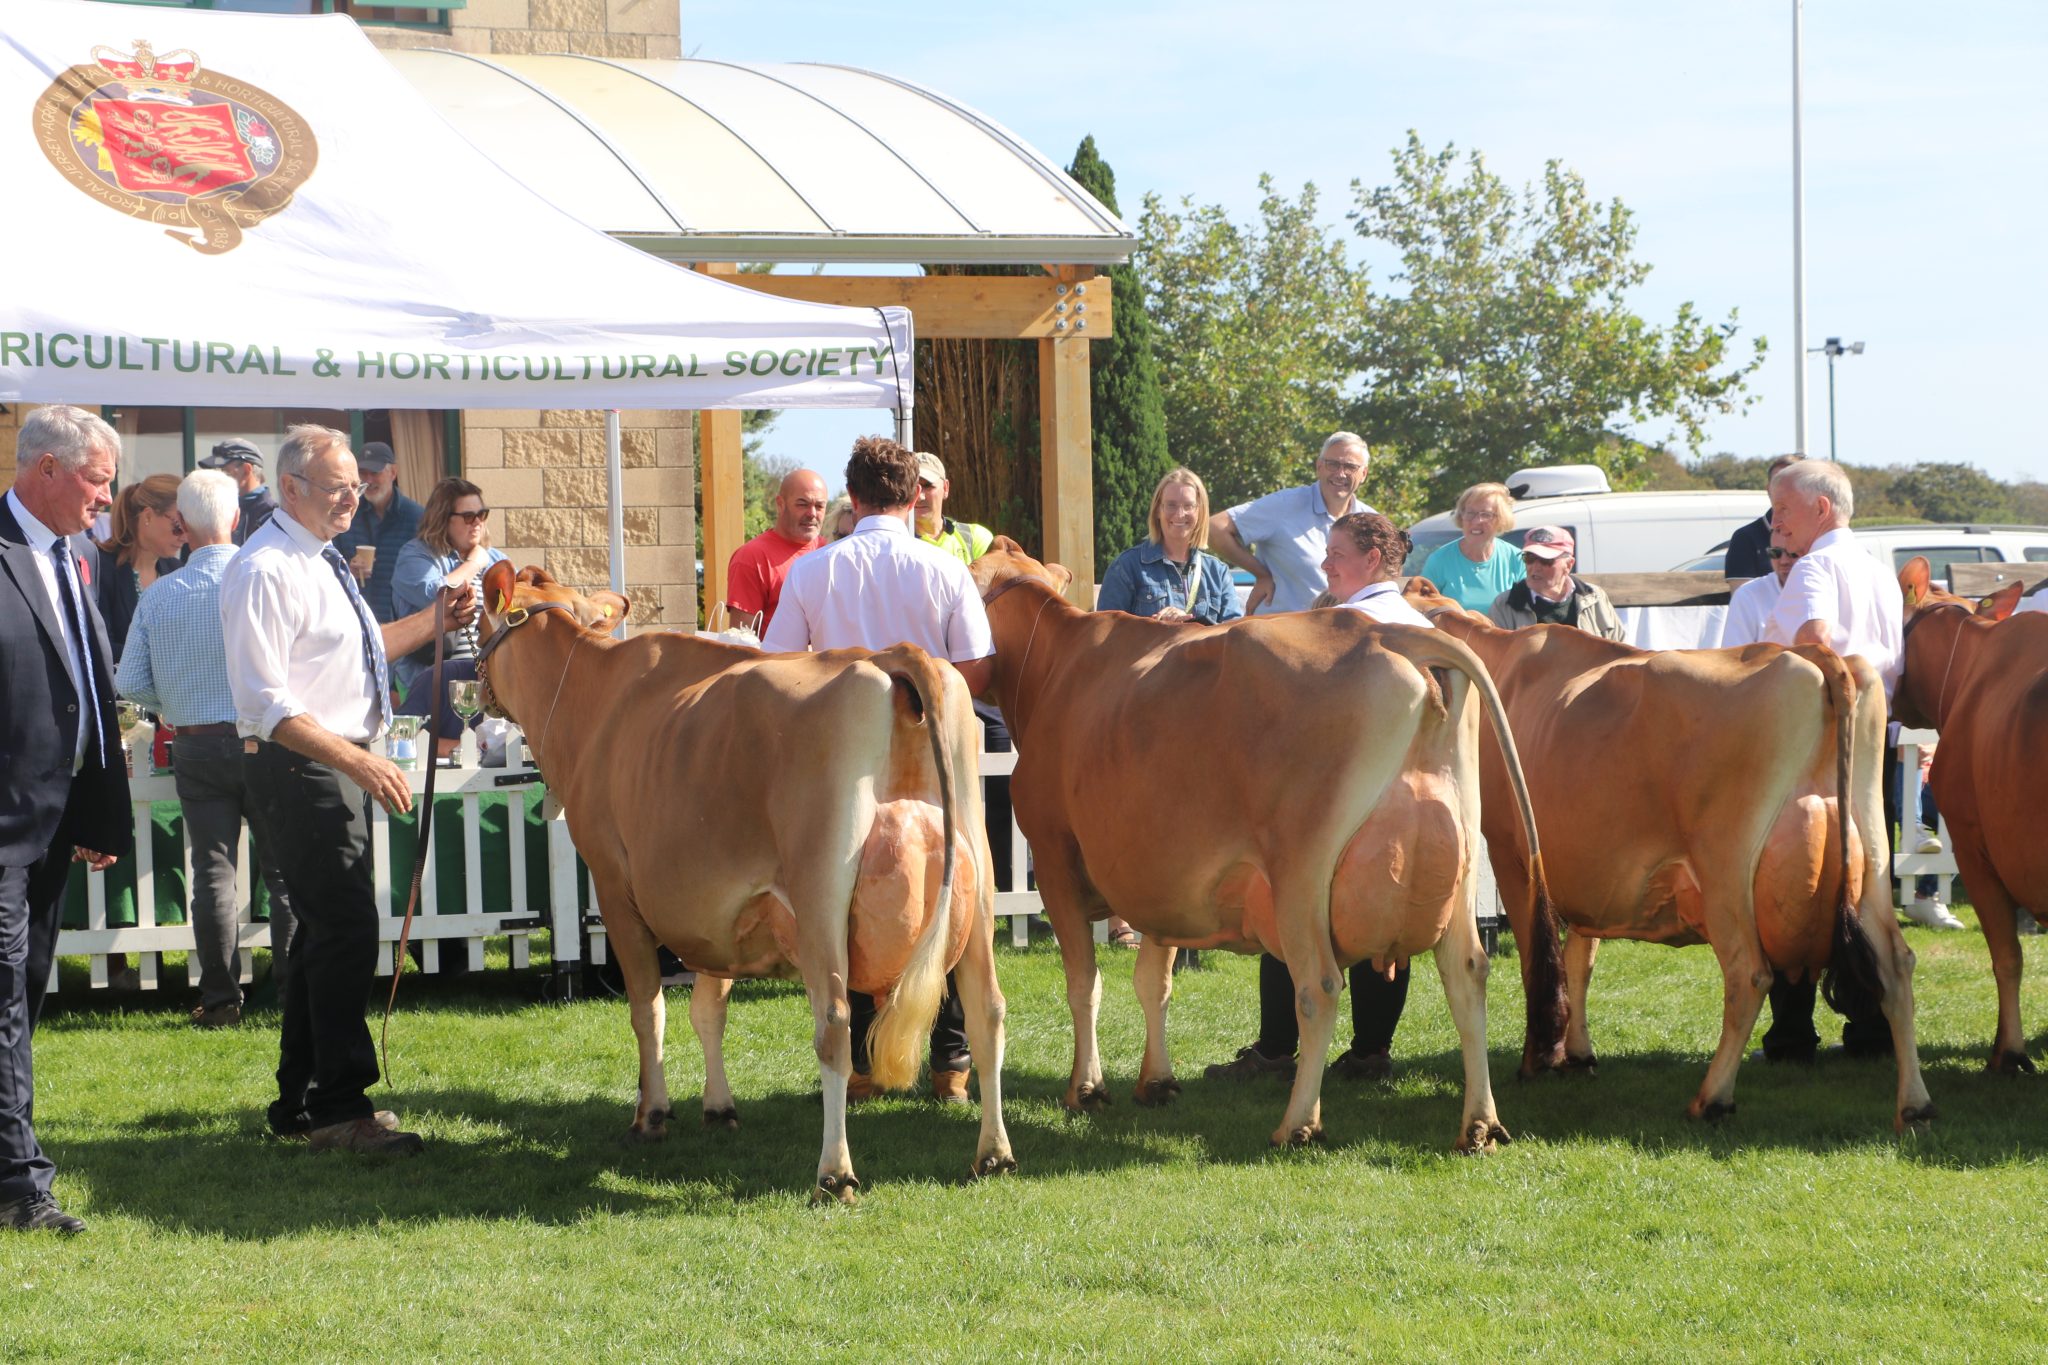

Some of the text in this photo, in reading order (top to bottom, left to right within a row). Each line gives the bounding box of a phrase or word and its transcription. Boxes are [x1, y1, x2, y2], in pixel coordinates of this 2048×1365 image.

[200, 76, 210, 85] &
[215, 79, 304, 150] HORTICULTURAL
[43, 134, 82, 177] JERSEY
[85, 178, 135, 208] ROYAL
[197, 202, 221, 223] EST
[311, 348, 341, 378] &
[357, 350, 709, 380] HORTICULTURAL
[722, 345, 892, 377] SOCIETY
